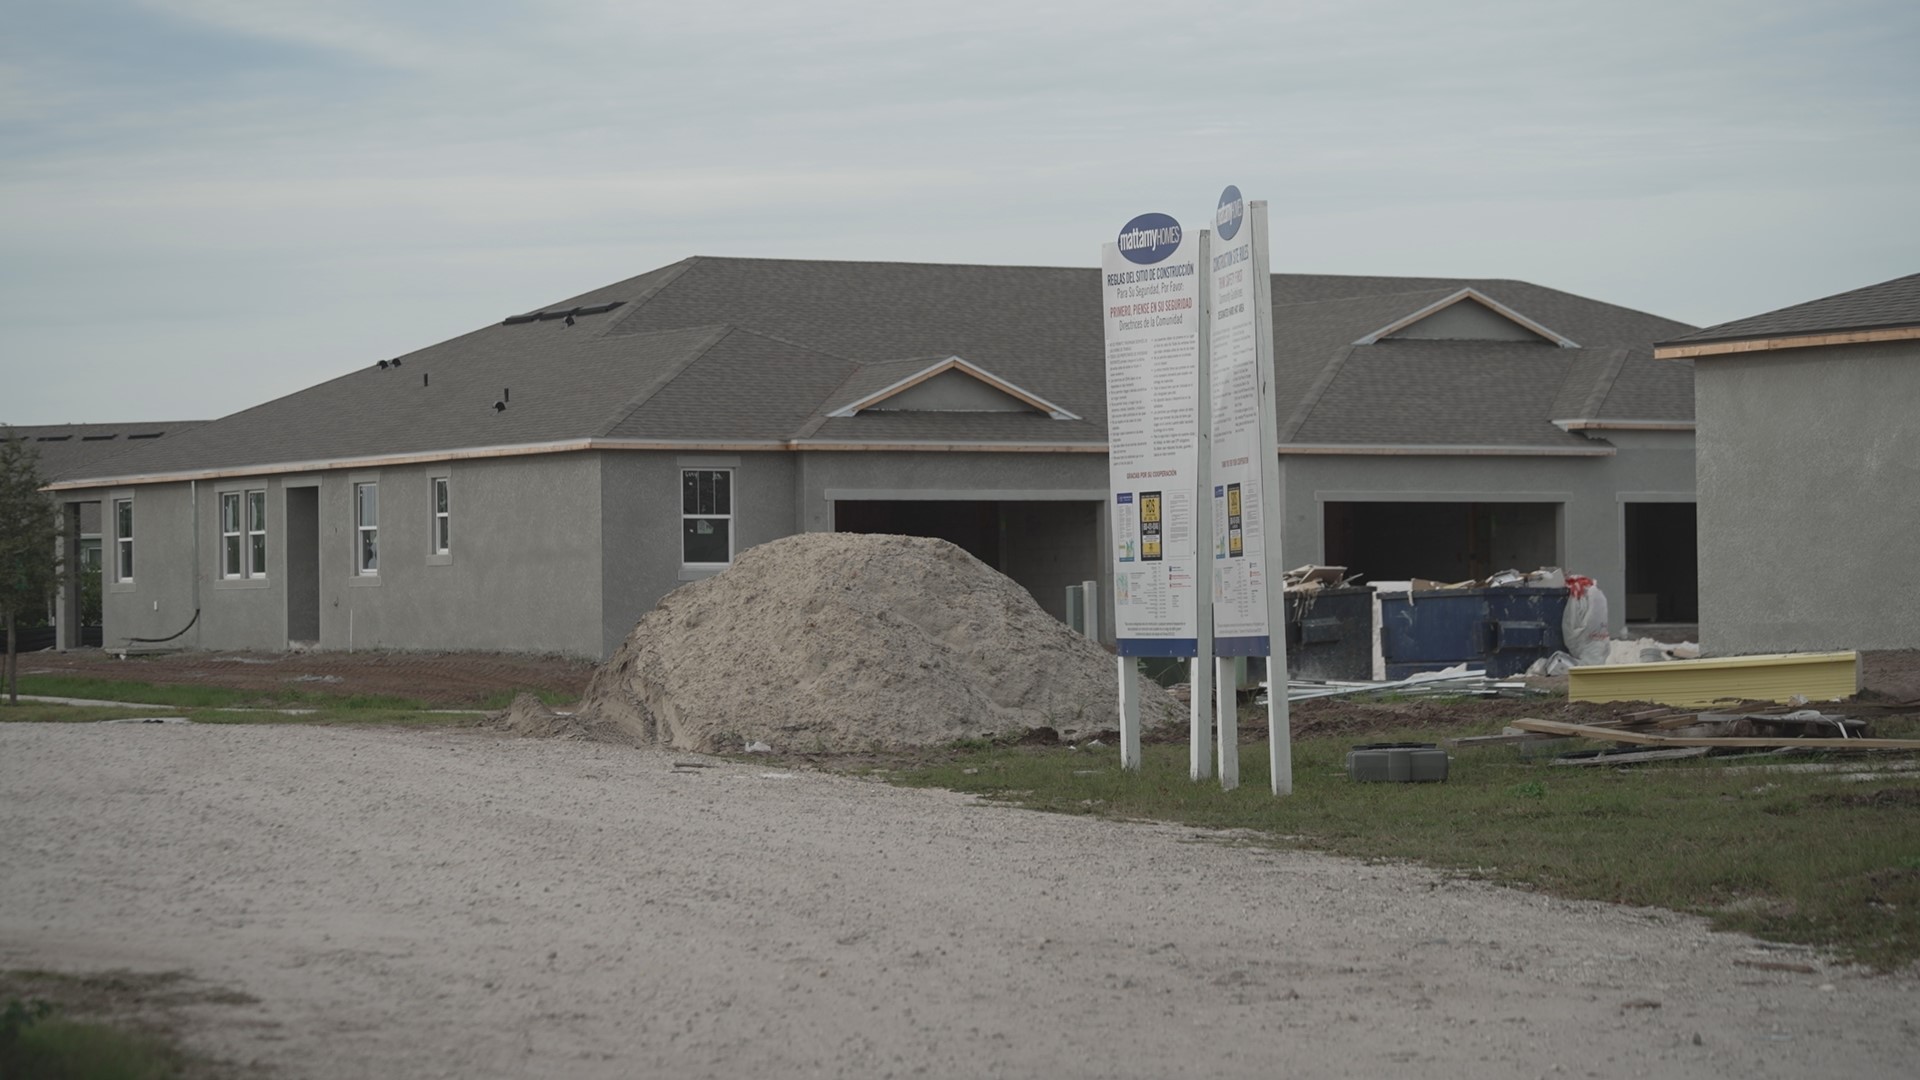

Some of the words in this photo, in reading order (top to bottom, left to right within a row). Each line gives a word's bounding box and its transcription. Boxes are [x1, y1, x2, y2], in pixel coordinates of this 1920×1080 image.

[1120, 225, 1180, 251] mattamyHOMES
[1107, 273, 1125, 286] REGLAS
[1126, 271, 1135, 284] DEL
[1136, 269, 1148, 282] SITIO
[1149, 268, 1156, 281] DE
[1157, 261, 1194, 280] CONSTRUCCIÓN
[1117, 288, 1128, 299] Para
[1129, 286, 1135, 298] Su
[1136, 284, 1160, 298] Seguridad,
[1161, 282, 1169, 293] Por
[1133, 302, 1150, 315] PIENSE
[1150, 301, 1157, 313] EN
[1158, 300, 1165, 312] SU
[1165, 297, 1193, 311] SEGURIDAD
[1119, 319, 1143, 331] Directrices
[1144, 318, 1149, 328] de
[1150, 317, 1155, 327] la
[1156, 314, 1182, 326] Comunidad
